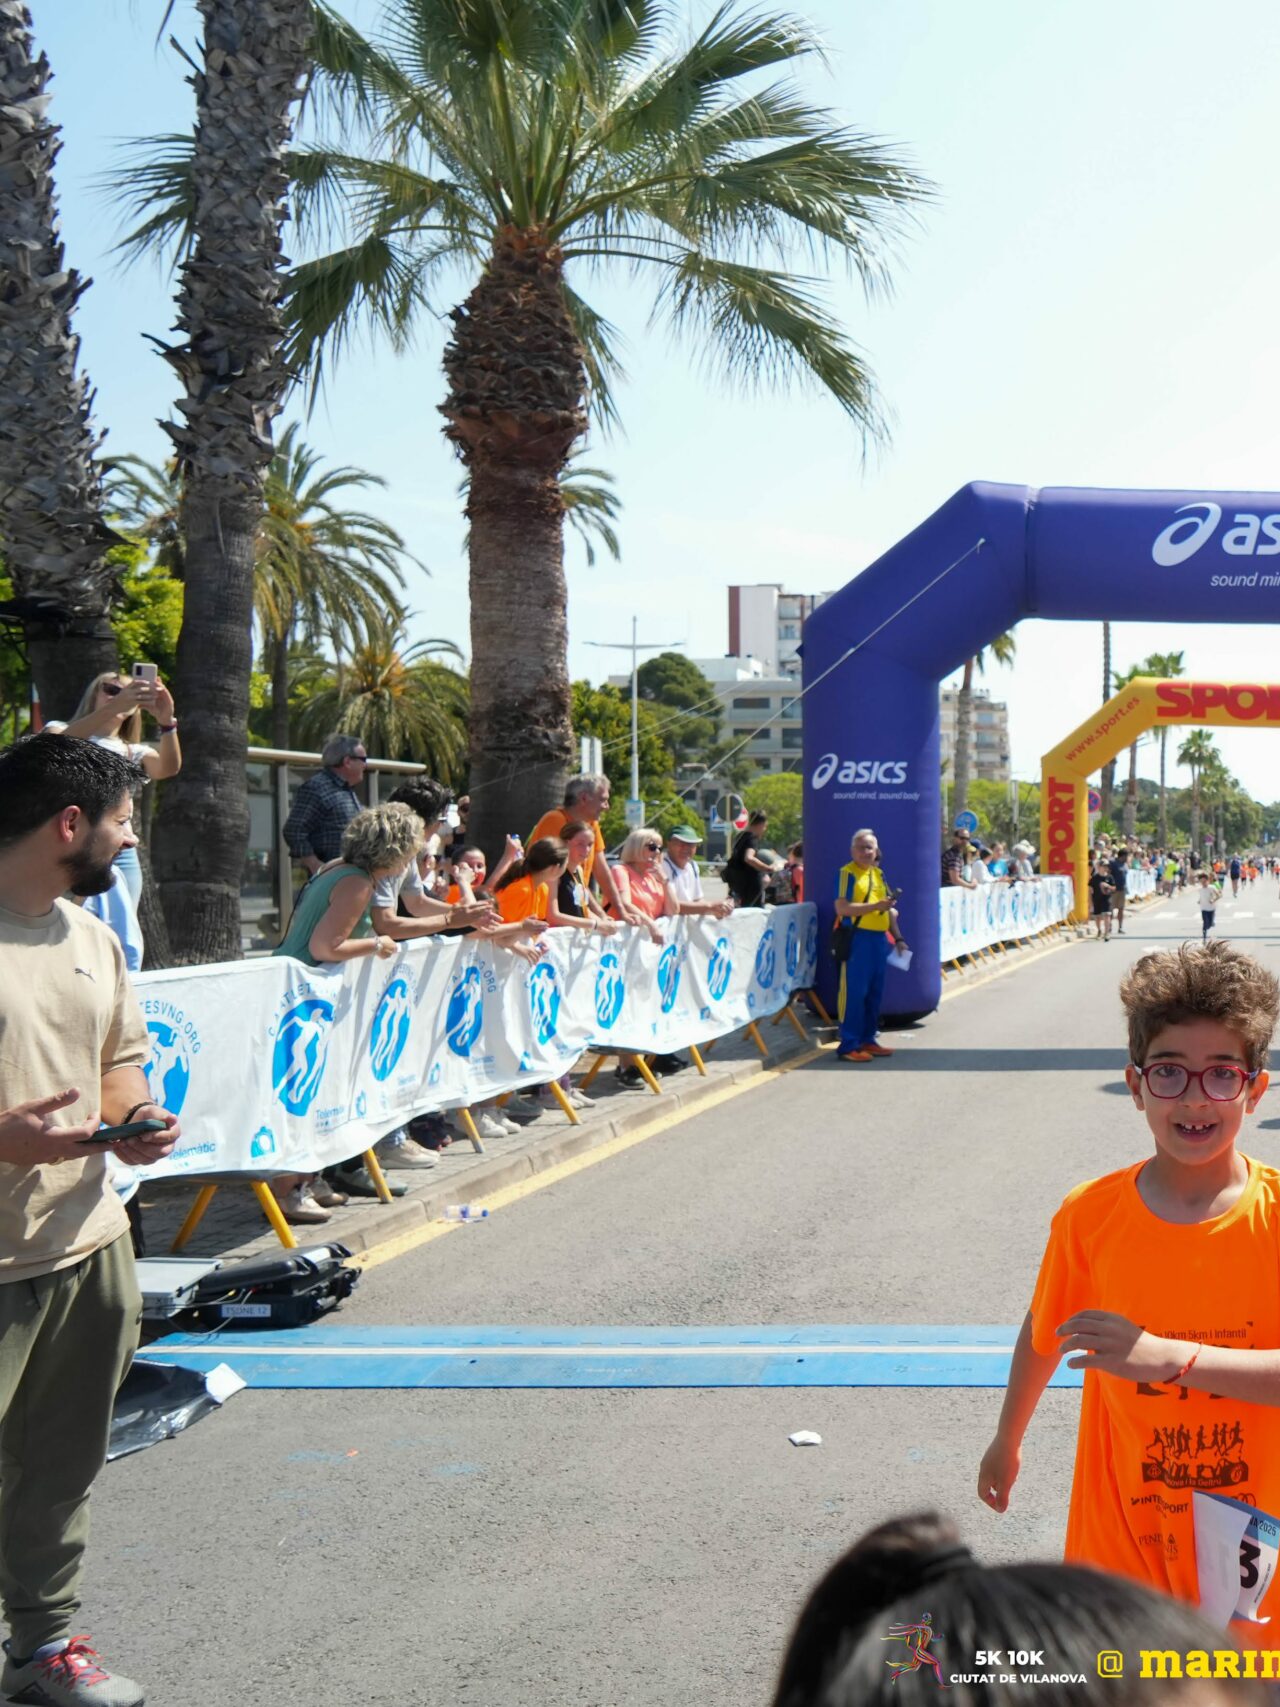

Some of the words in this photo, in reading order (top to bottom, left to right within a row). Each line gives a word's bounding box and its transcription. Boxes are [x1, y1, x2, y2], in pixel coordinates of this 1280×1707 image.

[1210, 572, 1258, 587] sound
[1066, 697, 1141, 762] www.sport.es
[1048, 776, 1075, 876] PORT
[1258, 1518, 1277, 1537] 2025
